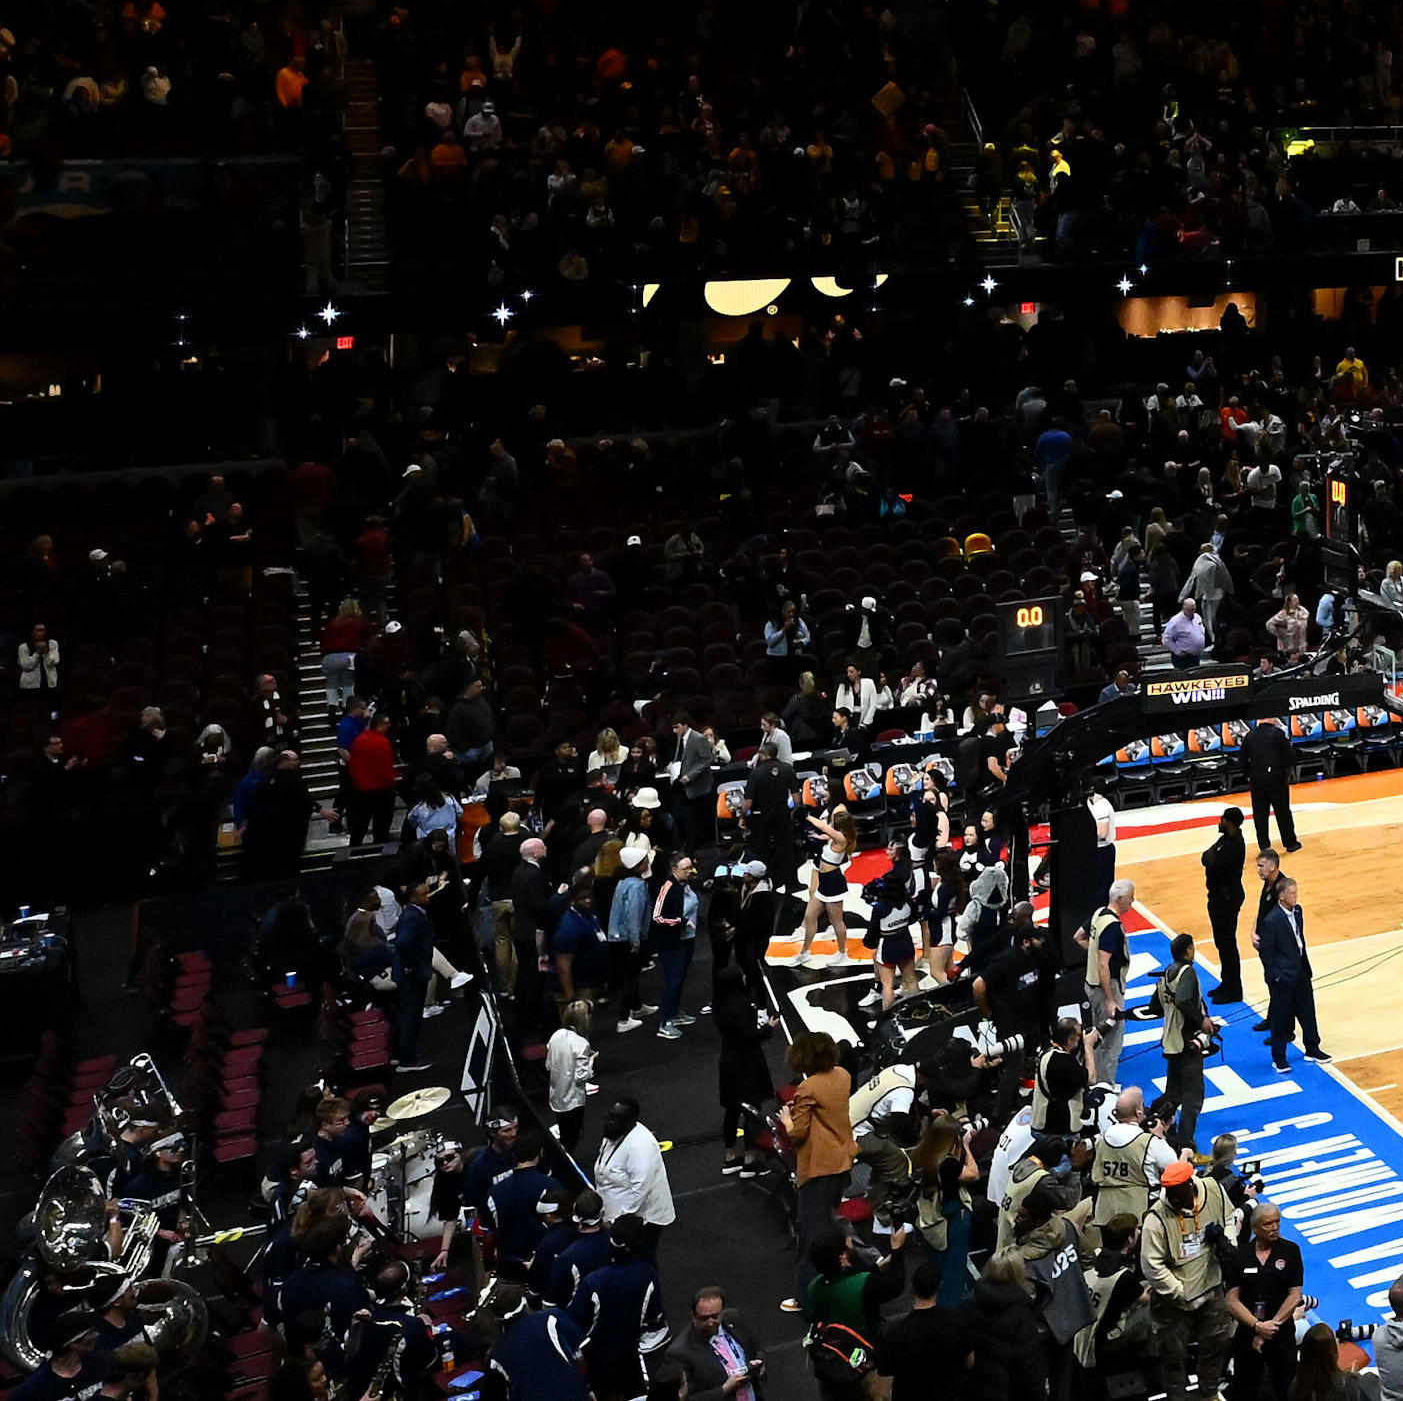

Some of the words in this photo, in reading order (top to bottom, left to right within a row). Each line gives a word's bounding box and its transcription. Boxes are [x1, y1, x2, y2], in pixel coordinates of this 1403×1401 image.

[1016, 606, 1043, 628] 0.0
[1149, 676, 1245, 695] HAWKEYES
[1171, 689, 1226, 705] WIN!!!
[1288, 692, 1341, 711] SPALDING
[1103, 1161, 1129, 1177] 578
